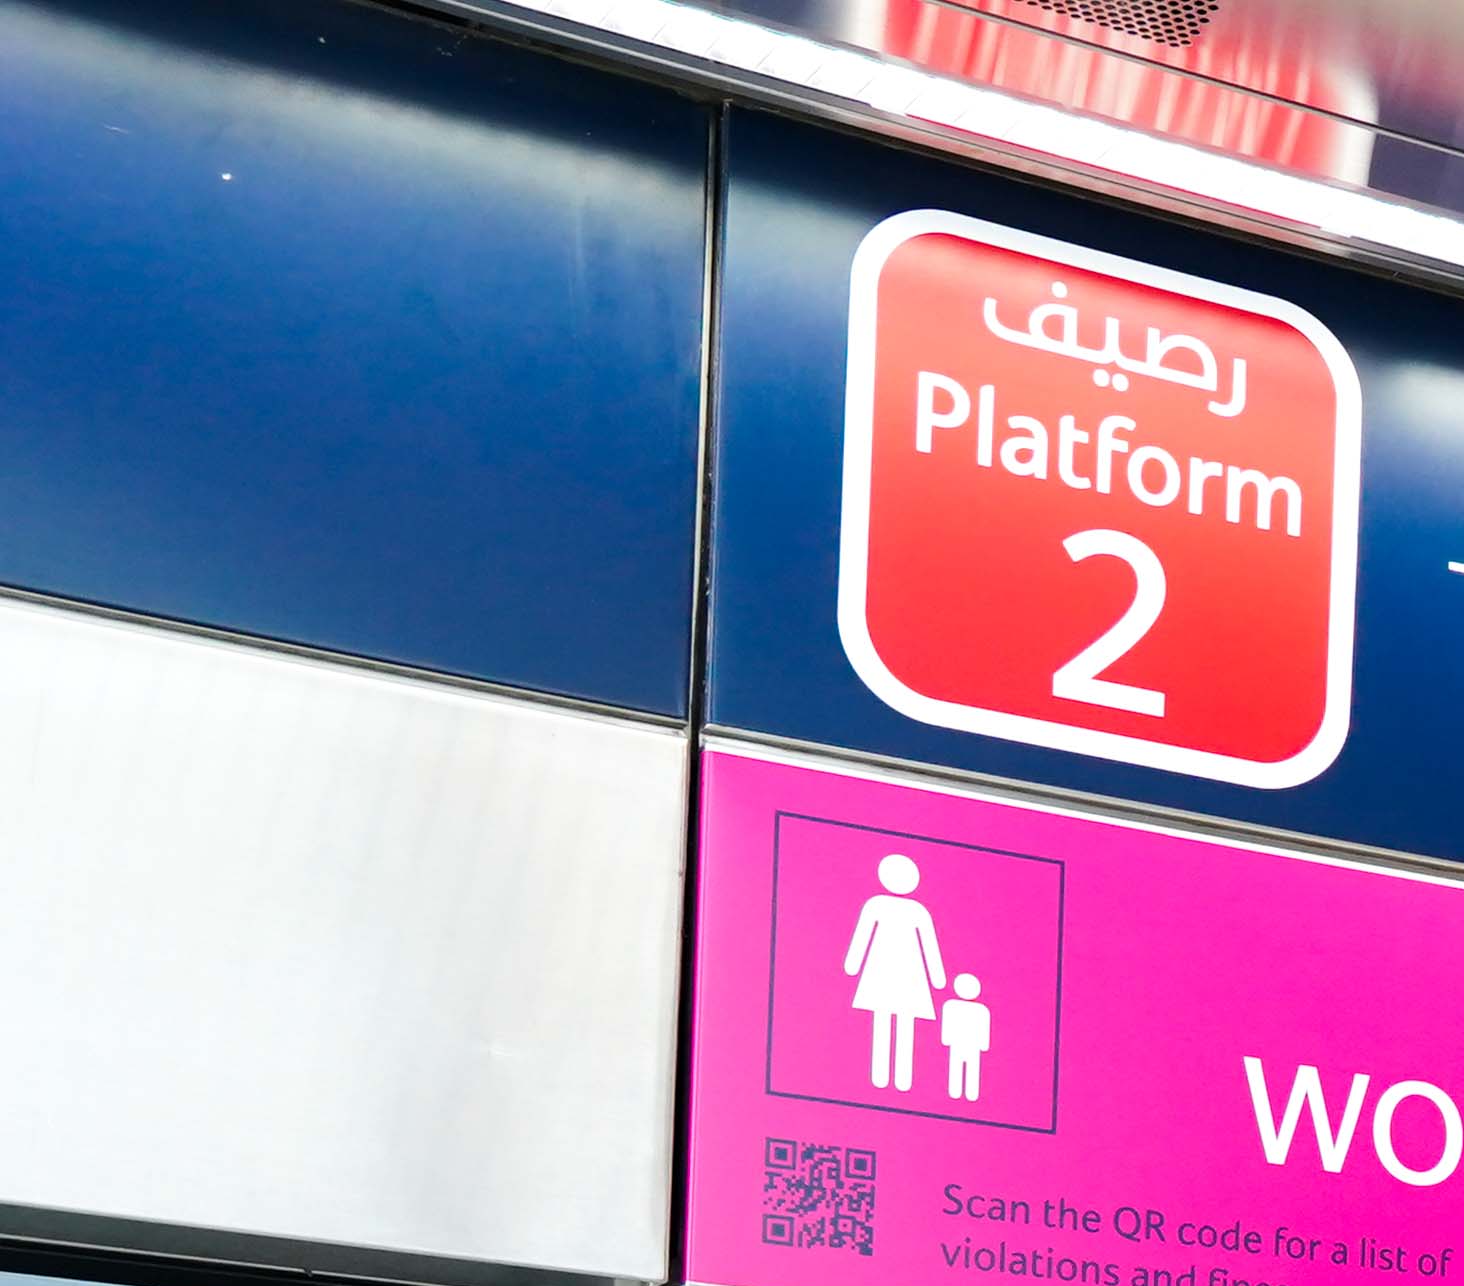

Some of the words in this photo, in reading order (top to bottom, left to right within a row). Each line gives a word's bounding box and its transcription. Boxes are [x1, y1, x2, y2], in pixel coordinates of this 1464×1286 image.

[983, 280, 1247, 418] رصيف
[914, 370, 1303, 538] Platform
[1050, 528, 1167, 718] 2
[941, 1181, 1035, 1228] Scan
[1041, 1195, 1105, 1235] the
[1111, 1203, 1169, 1249] QR
[1176, 1209, 1264, 1253] code
[1272, 1222, 1323, 1262] for
[1328, 1237, 1350, 1265] a
[1357, 1231, 1408, 1273] list
[1414, 1243, 1456, 1282] of
